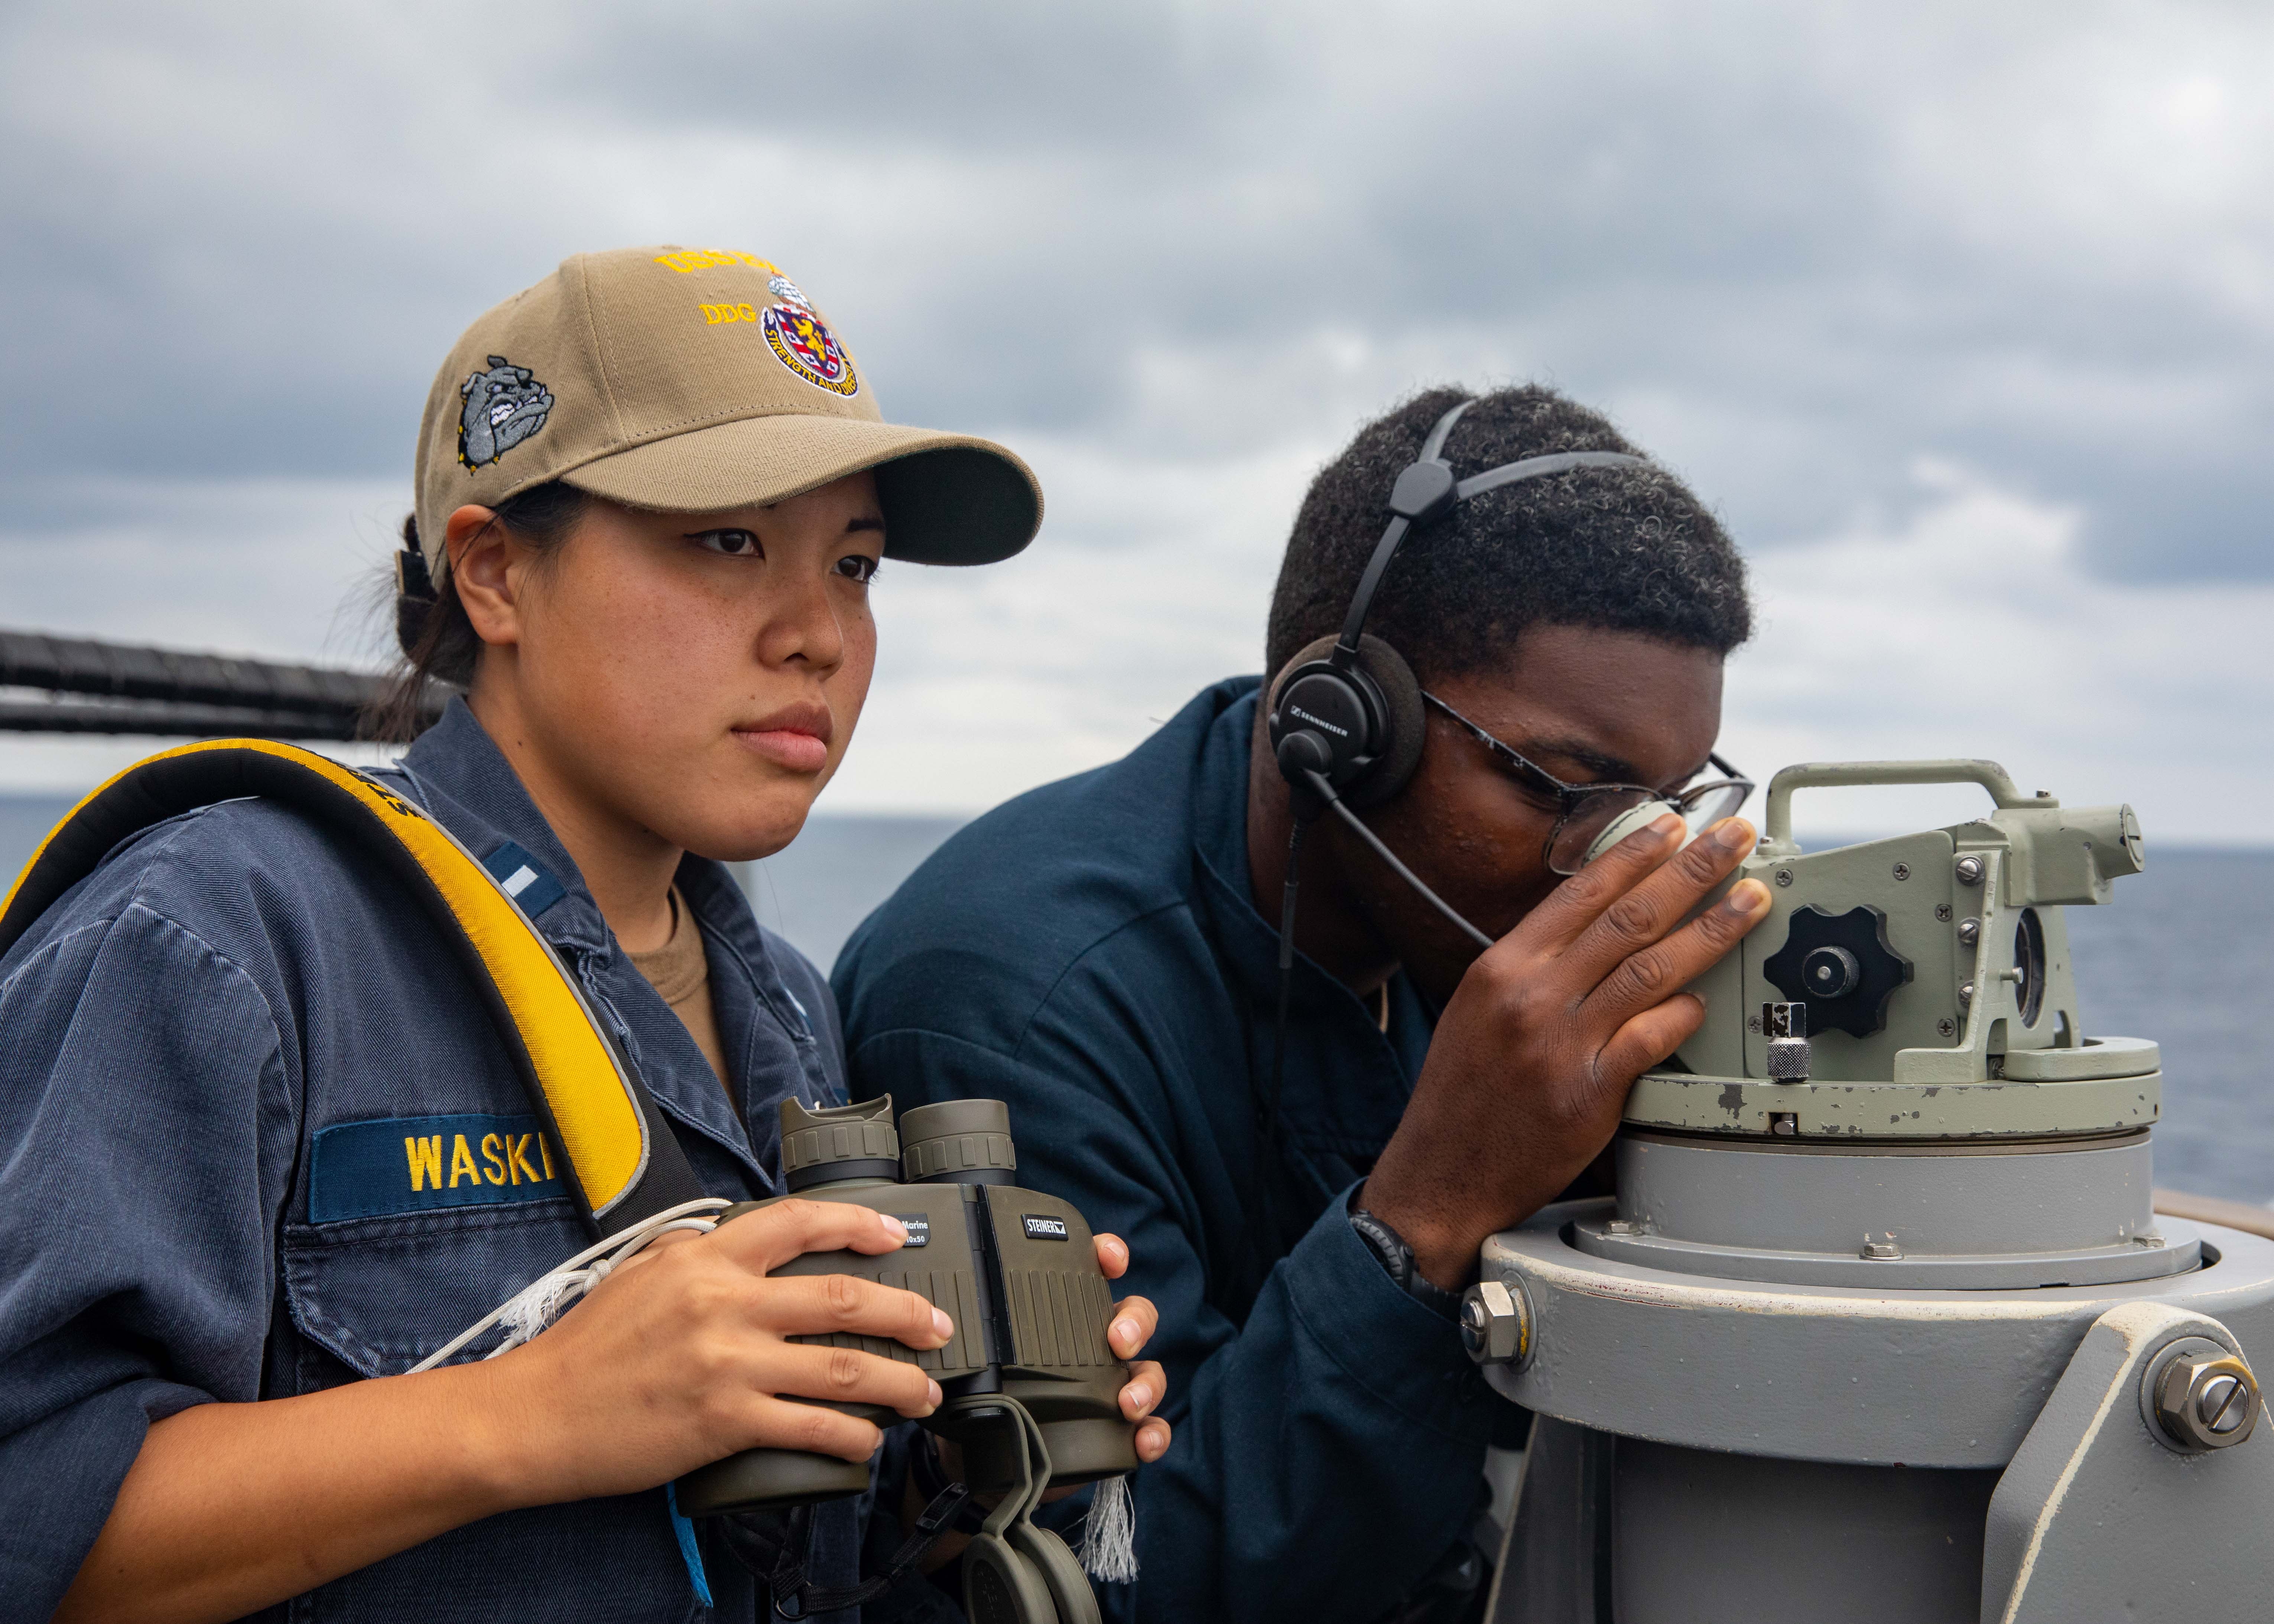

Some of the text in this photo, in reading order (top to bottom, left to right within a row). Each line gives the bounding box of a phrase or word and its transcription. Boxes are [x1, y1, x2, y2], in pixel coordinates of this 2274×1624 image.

[654, 250, 737, 273] USS
[699, 303, 756, 325] DDG
[766, 329, 816, 384] STRENGTH
[819, 377, 842, 394] AND
[405, 1132, 556, 1191] WASKI
[902, 1220, 928, 1229] Marine
[1027, 1219, 1056, 1233] STEINER
